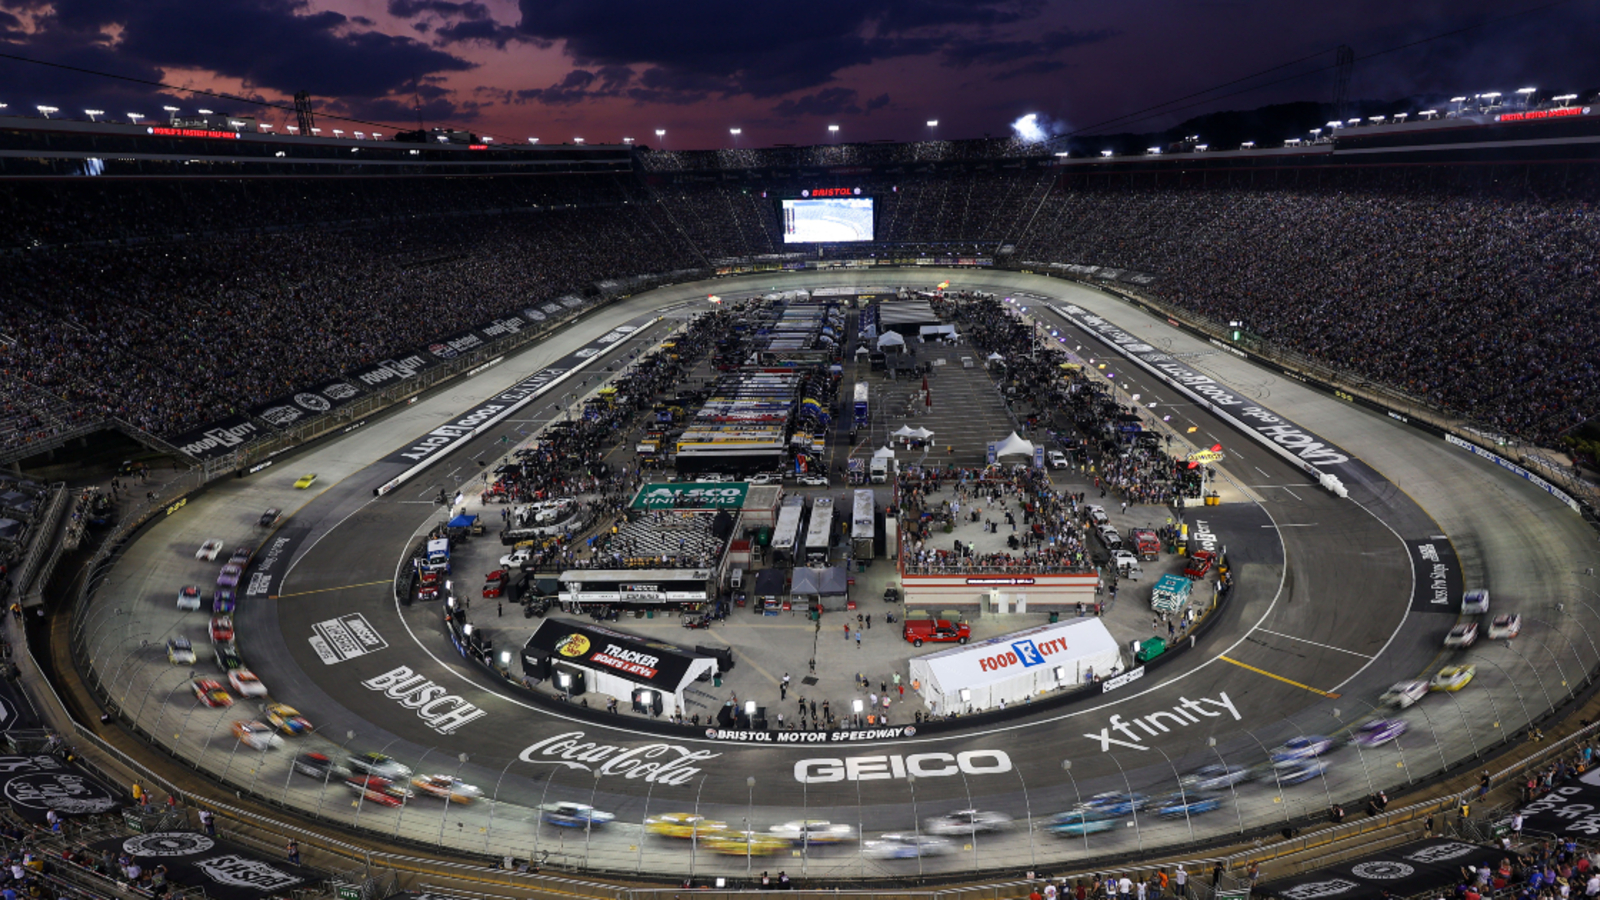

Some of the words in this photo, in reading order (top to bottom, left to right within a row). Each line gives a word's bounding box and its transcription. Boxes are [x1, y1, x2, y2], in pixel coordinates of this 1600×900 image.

[811, 188, 852, 197] BRISTOL
[359, 365, 395, 385] FOOD
[399, 354, 428, 371] CITY
[180, 438, 218, 456] FOOD
[228, 421, 258, 438] CITY
[401, 436, 451, 461] CITY
[593, 654, 622, 668] BOATS
[629, 665, 653, 677] ATVs
[603, 643, 660, 668] TRACKER
[979, 652, 1018, 672] FOOD
[1038, 636, 1068, 657] CITY
[361, 664, 487, 736] BUSCH
[717, 730, 772, 741] BRISTOL
[777, 731, 827, 742] MOTOR
[831, 727, 904, 742] SPEEDWAY
[1083, 690, 1242, 753] xfinity
[794, 749, 1012, 785] GEICO
[207, 856, 282, 888] BUSH'S
